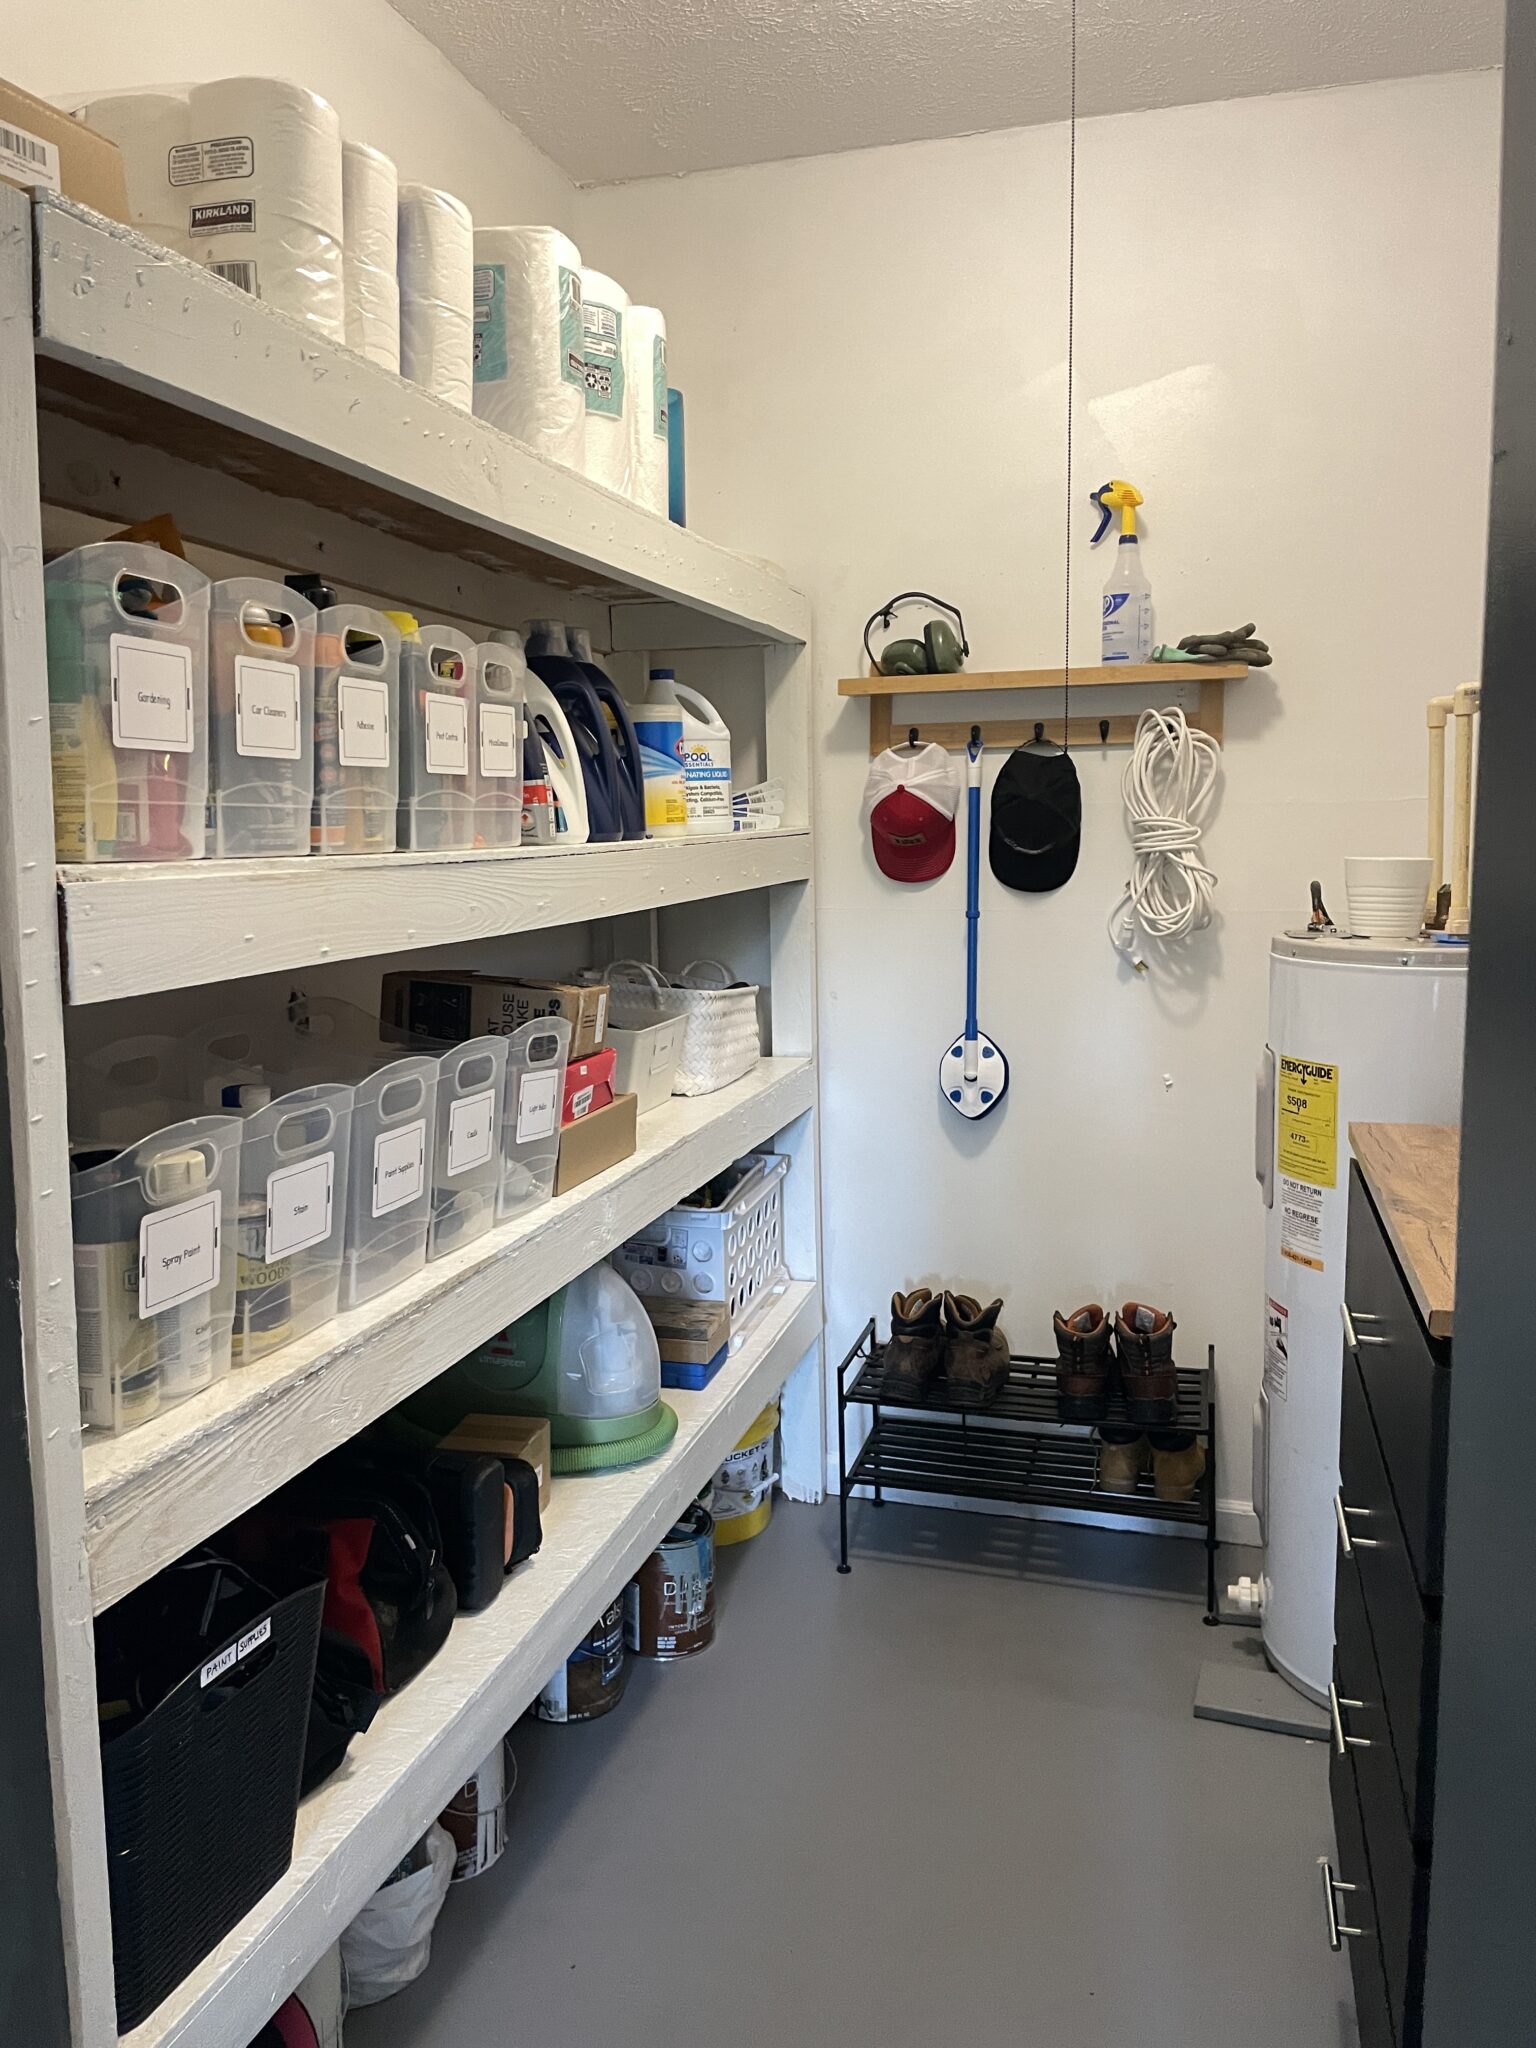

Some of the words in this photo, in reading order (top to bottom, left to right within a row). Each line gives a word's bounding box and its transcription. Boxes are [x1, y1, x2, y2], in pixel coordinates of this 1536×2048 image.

[195, 204, 249, 220] KIRKLAND
[138, 691, 171, 709] Gardening
[251, 704, 262, 715] Car
[263, 706, 287, 718] Cleaners
[685, 752, 712, 761] POOL
[502, 993, 514, 1034] OUSE
[517, 1000, 528, 1027] AKE
[488, 1017, 500, 1034] AT
[1281, 1059, 1333, 1080] ENERGYGUIDE
[1287, 1095, 1307, 1109] $508
[384, 1167, 398, 1179] Paint
[1290, 1181, 1299, 1190] NOT
[1300, 1185, 1322, 1197] RETURN
[293, 1204, 308, 1216] Stain
[1292, 1210, 1319, 1225] REGRESE
[162, 1253, 182, 1271] Spray
[183, 1244, 201, 1259] Paint
[725, 1446, 761, 1462] UCKET
[206, 1652, 232, 1679] PAINT
[239, 1624, 267, 1652] SUPPLIES
